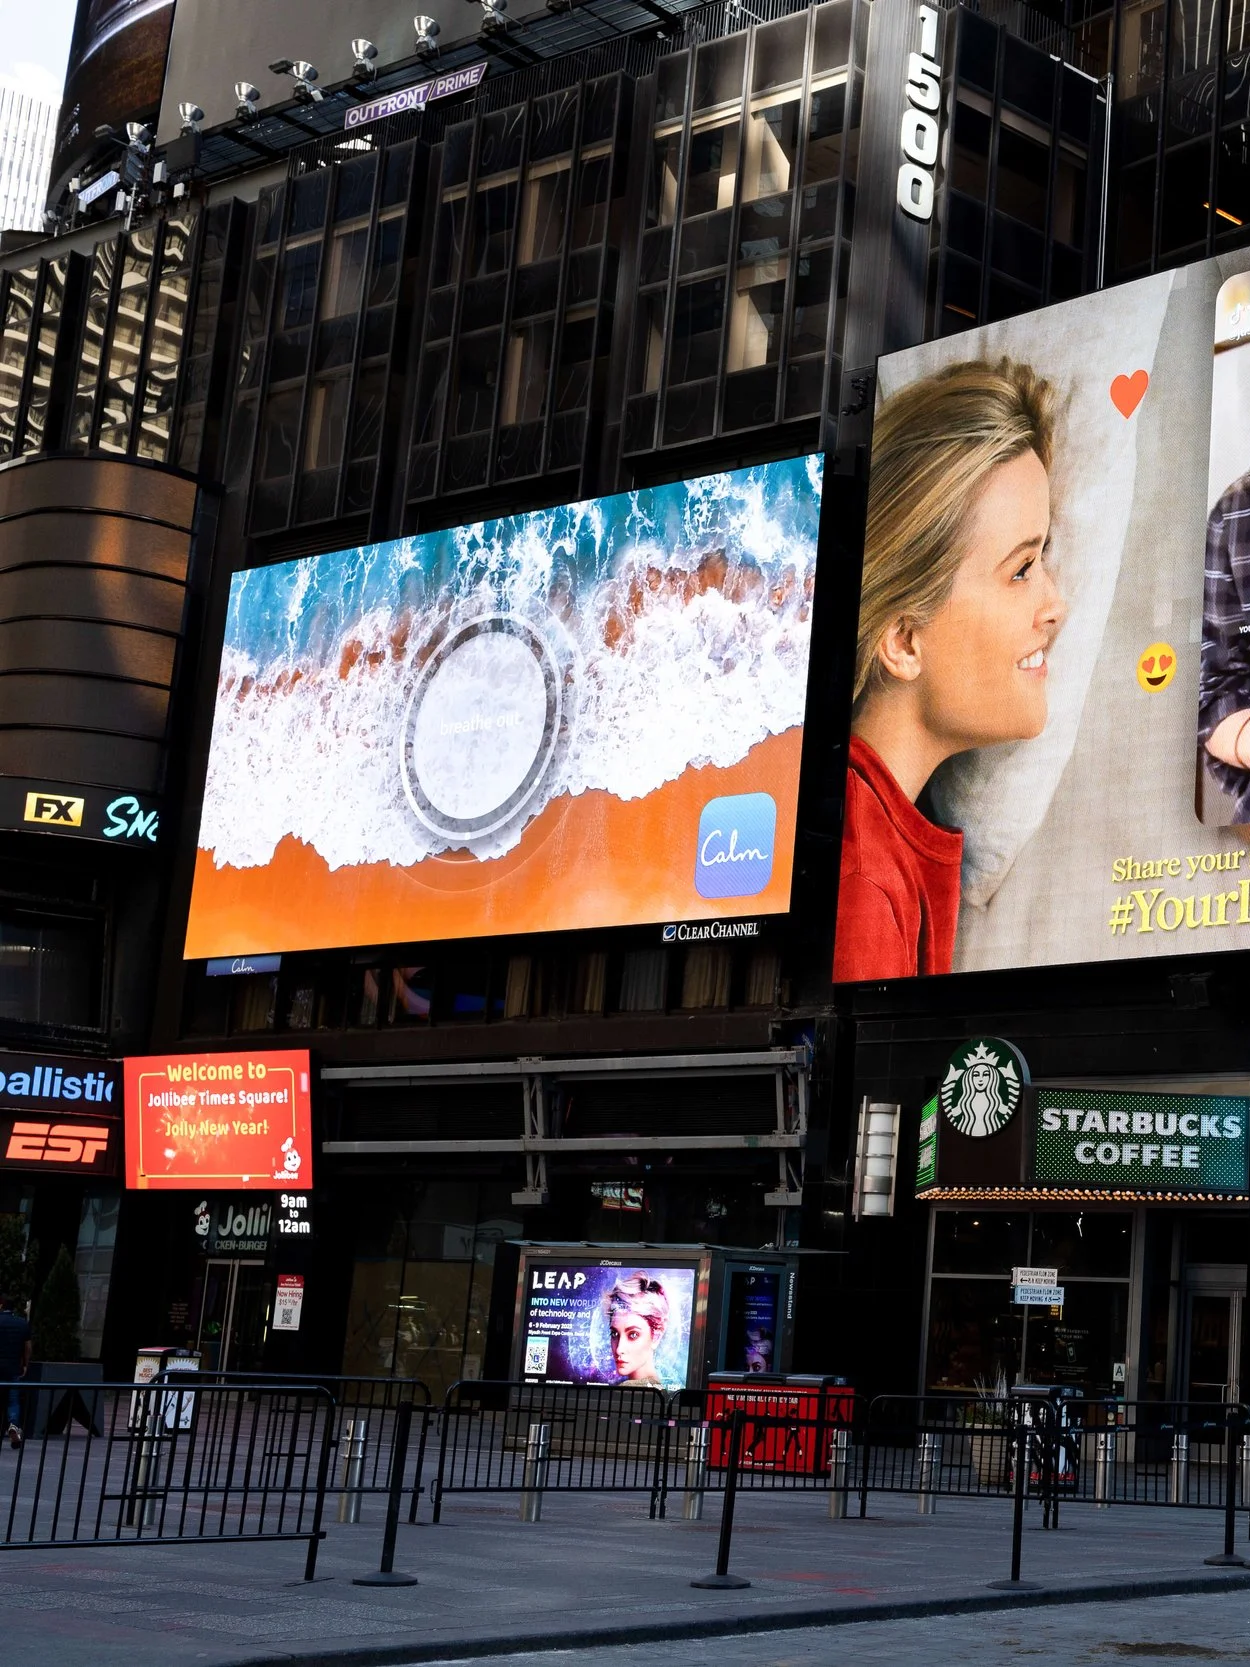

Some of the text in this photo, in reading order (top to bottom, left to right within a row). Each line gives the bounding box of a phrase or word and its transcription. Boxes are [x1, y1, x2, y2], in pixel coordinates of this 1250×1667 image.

[349, 68, 480, 125] OUTFRONT PRIME
[897, 5, 941, 220] 1500
[440, 711, 521, 737] breathe out
[34, 797, 76, 822] FX
[701, 829, 769, 867] Calm
[1111, 856, 1179, 883] Share
[1186, 852, 1245, 880] your
[231, 959, 255, 973] Calm
[167, 1061, 267, 1083] Welcome to
[148, 1088, 288, 1108] Jollibee Times Square!
[165, 1119, 268, 1140] Jolly New Year!
[1042, 1107, 1242, 1139] STARBUCKS
[1075, 1140, 1200, 1168] COFFEE
[280, 1194, 307, 1208] 9am
[289, 1208, 299, 1218] to
[278, 1219, 310, 1234] 12am
[532, 1271, 586, 1290] LEAP
[277, 1289, 303, 1300] Now Hiring
[531, 1298, 548, 1306] INTO
[549, 1298, 568, 1307] NEW
[786, 1272, 795, 1319] Newsstand
[530, 1308, 591, 1320] of technology and
[539, 1322, 561, 1330] February
[1115, 1366, 1123, 1377] A
